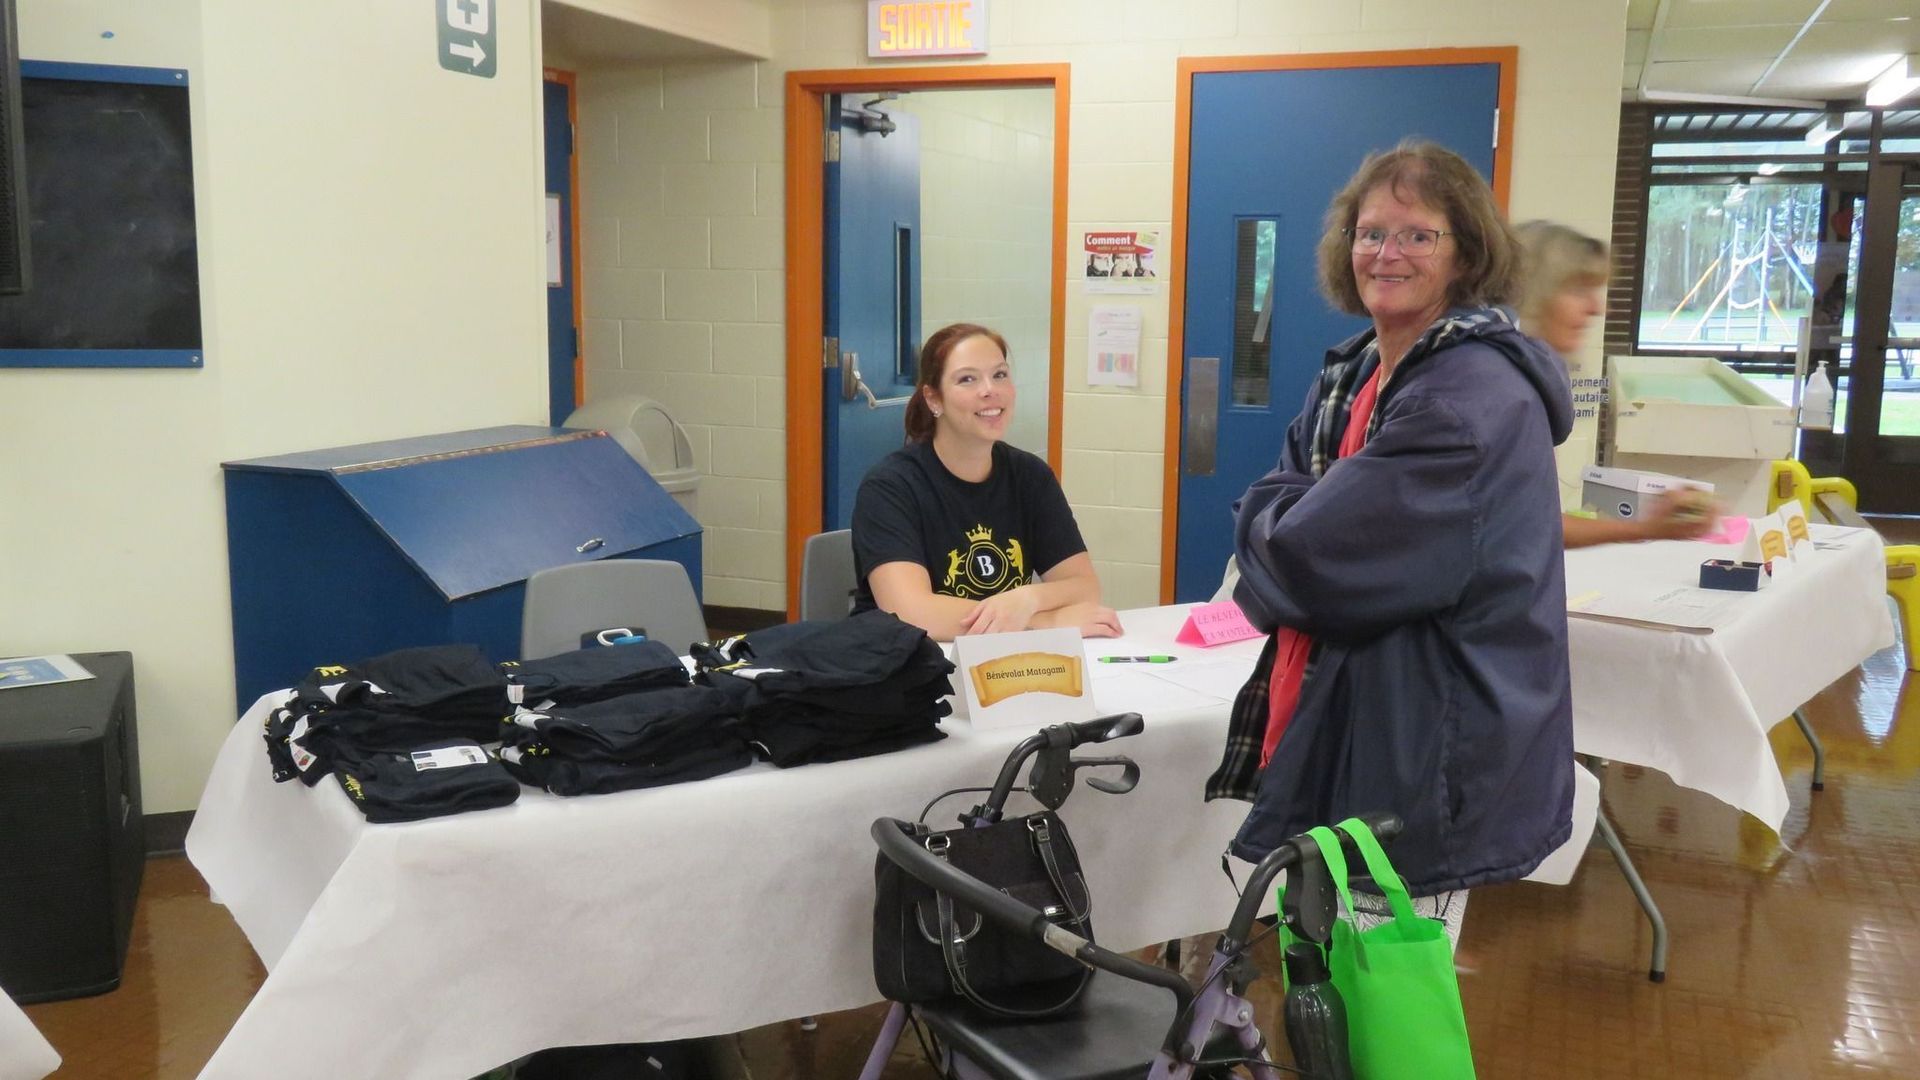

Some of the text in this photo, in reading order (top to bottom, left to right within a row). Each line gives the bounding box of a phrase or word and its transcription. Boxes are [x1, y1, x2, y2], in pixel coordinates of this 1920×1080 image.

[880, 2, 972, 51] SORTIE
[1087, 235, 1130, 245] Comment
[1571, 378, 1609, 389] pement
[1573, 391, 1609, 403] autaire
[976, 555, 995, 576] B
[986, 665, 1066, 680] Bénévolat Matagami
